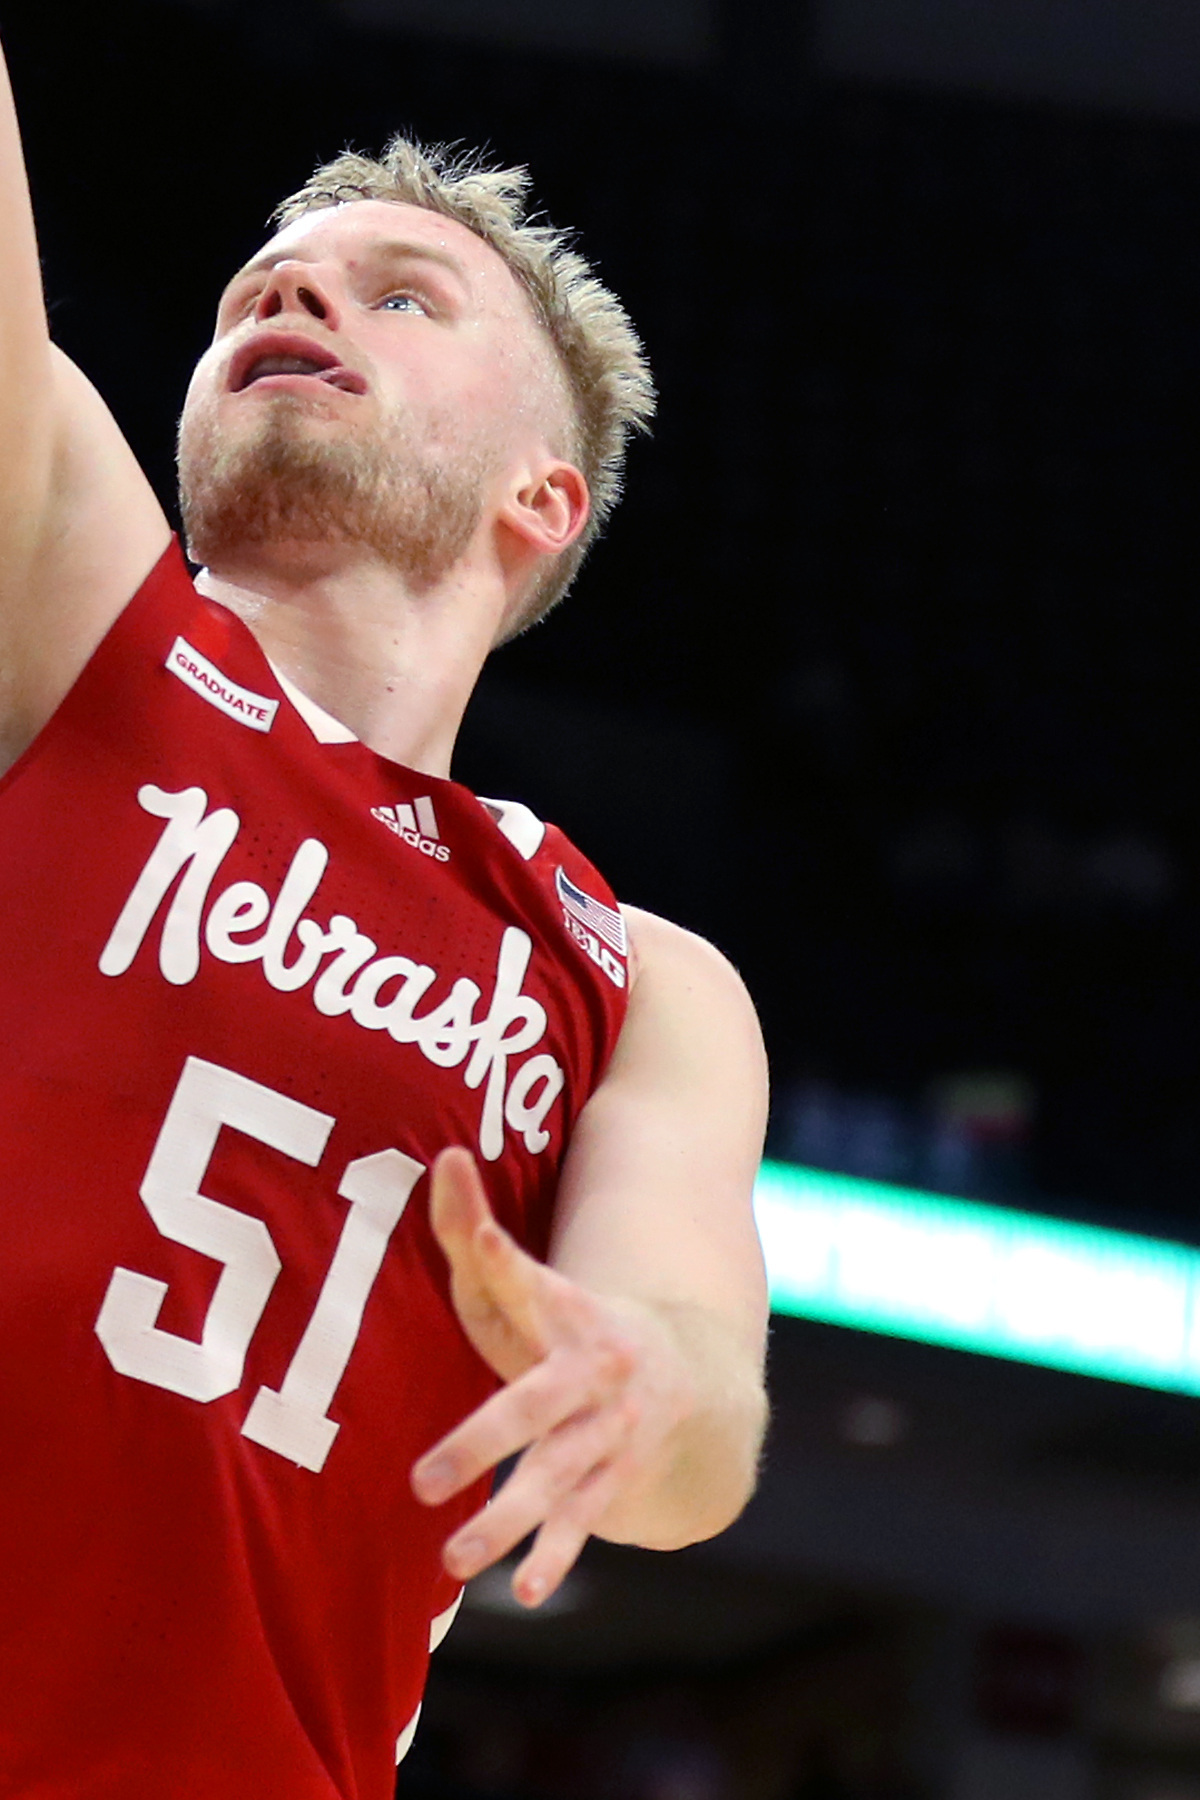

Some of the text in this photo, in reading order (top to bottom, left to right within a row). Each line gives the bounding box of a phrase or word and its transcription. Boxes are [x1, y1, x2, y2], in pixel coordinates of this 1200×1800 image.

[176, 653, 269, 721] GRADUATE
[370, 806, 452, 863] adidas
[98, 783, 565, 1162] Nebraska
[94, 1055, 427, 1474] 51
